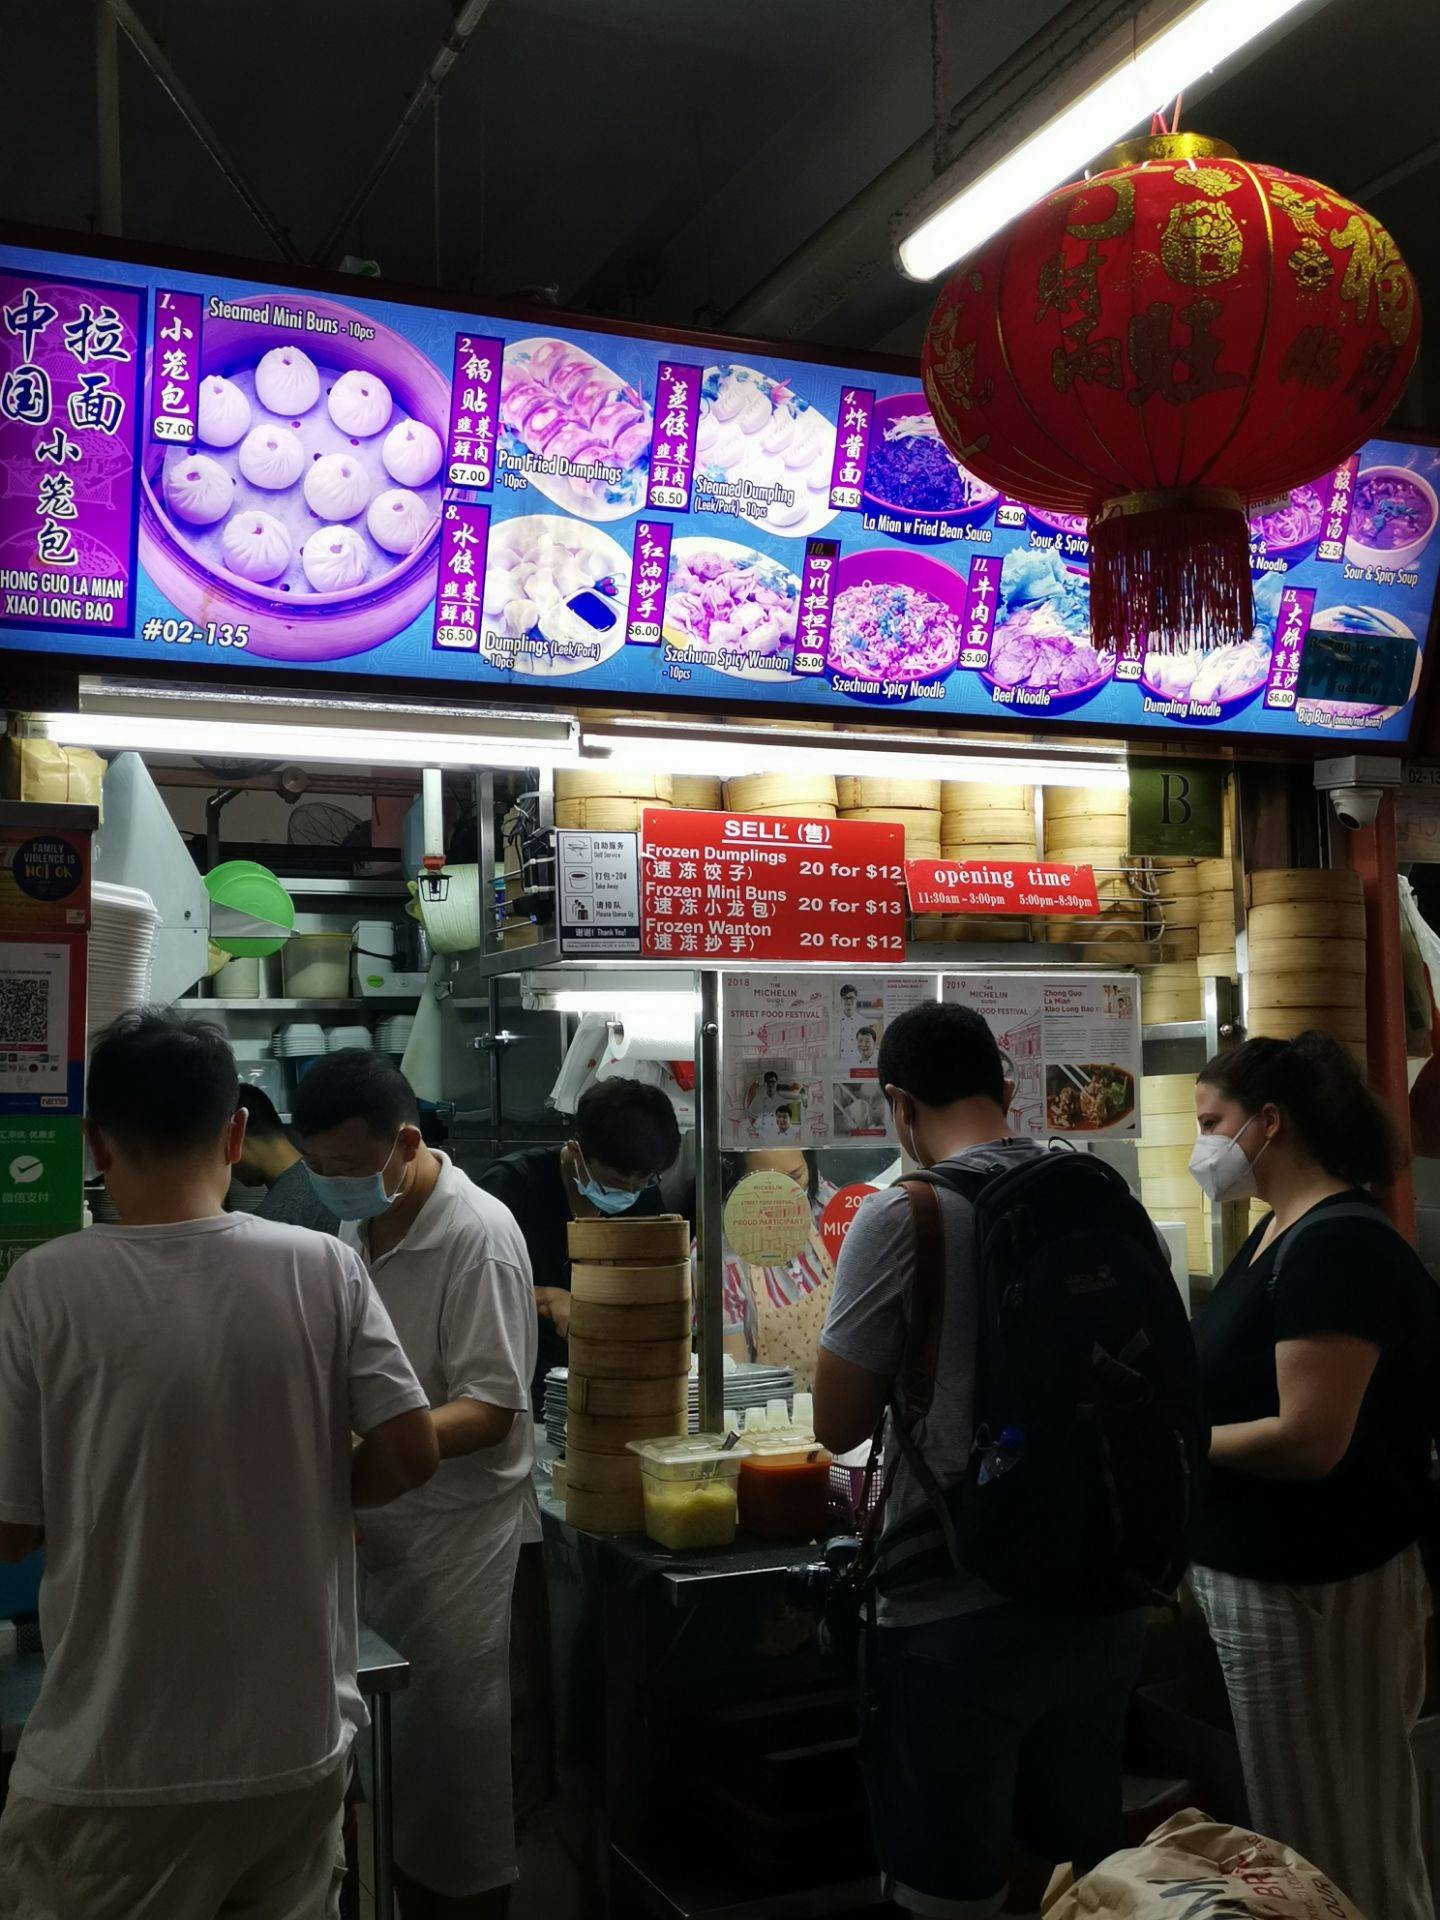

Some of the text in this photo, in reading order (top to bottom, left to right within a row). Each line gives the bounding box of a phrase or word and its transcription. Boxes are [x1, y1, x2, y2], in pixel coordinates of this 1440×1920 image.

[210, 297, 375, 341] Steamed Mini Buns 10pcs
[1, 287, 57, 426] 中国
[159, 316, 194, 415] 小笼包
[64, 304, 131, 436] 拉面
[460, 354, 492, 413] 锅贴
[660, 381, 690, 440] 蒸饺
[155, 420, 195, 437] $7.00
[453, 416, 494, 438] 韭菜
[452, 440, 489, 464] 鲜肉
[654, 442, 690, 464] 韭菜
[840, 407, 868, 485] 炸酱面
[451, 469, 485, 482] $7.00
[498, 451, 622, 485] Pan Fried Dumplings
[651, 466, 686, 487] 鲜肉
[503, 473, 527, 490] 10pcs
[696, 475, 795, 507] Steamed Dumpling
[36, 428, 82, 566] 小笼包
[650, 492, 683, 506] $6.50
[832, 490, 861, 505] $4.50
[746, 502, 768, 518] 10pcs
[998, 511, 1026, 522] $4.00
[863, 513, 992, 542] La Mian w Fried Bean Sauce
[448, 522, 480, 576] 水饺
[1030, 531, 1089, 556] Sour & Spicy
[1318, 543, 1343, 557] $2.50
[1256, 557, 1288, 573] Noodle
[0, 570, 124, 599] HONG GUO LA MIAN
[636, 540, 665, 619] 红油抄手
[1343, 564, 1418, 588] Sour & Spicy Soup
[441, 580, 480, 602] 韭菜
[5, 594, 113, 622] XIAO LONG BAO
[801, 558, 832, 650] 四川担担面
[967, 576, 994, 646] 牛肉面
[439, 605, 475, 626] 鲜肉
[142, 618, 250, 648] #02-135
[439, 629, 473, 641] $6.50
[628, 624, 659, 637] $6.00
[1281, 603, 1303, 651] 大饼
[485, 631, 549, 655] Dumplings
[491, 653, 514, 670] 10pcs
[664, 645, 789, 671] Szechuan Spicy Wanton
[795, 656, 824, 668] $5.00
[960, 652, 987, 663] $5.00
[669, 666, 691, 681] 10pcs
[1116, 664, 1142, 676] $4.00
[832, 675, 945, 699] Szechuan Spicy Noodle
[993, 687, 1050, 706] Beef Noodle
[1144, 698, 1221, 717] Dumpling Noodle
[1269, 693, 1293, 704] $6.00
[1298, 708, 1331, 725] Big Bun
[1158, 771, 1193, 828] B
[724, 819, 831, 843] SELL (售)
[33, 843, 64, 853] FAMILY
[645, 844, 787, 864] Frozen Dumplings
[24, 853, 76, 864] VIOLENCE IS
[646, 861, 753, 881] (速冻饺子)
[799, 861, 902, 880] 20 for $12
[934, 866, 1072, 888] opening time
[646, 882, 787, 902] Frozen Mini Buns
[918, 892, 960, 904] 11:30am
[969, 893, 1005, 906] 3:00pm
[798, 898, 902, 916] 20 for $13
[646, 918, 771, 938] Frozen Wanton
[646, 933, 754, 953] (速冻抄手)
[800, 932, 903, 950] 20 for $12
[727, 978, 750, 987] 2018
[946, 981, 966, 989] 2019
[753, 988, 797, 998] MICHELIN
[970, 991, 1008, 999] MICHELIN
[1044, 990, 1067, 998] Zhong
[730, 1010, 820, 1019] STREET FOOD FESTIVAL
[998, 1008, 1028, 1016] FESTIVAL
[1044, 1005, 1061, 1013] Xiao
[1062, 1006, 1079, 1014] Long
